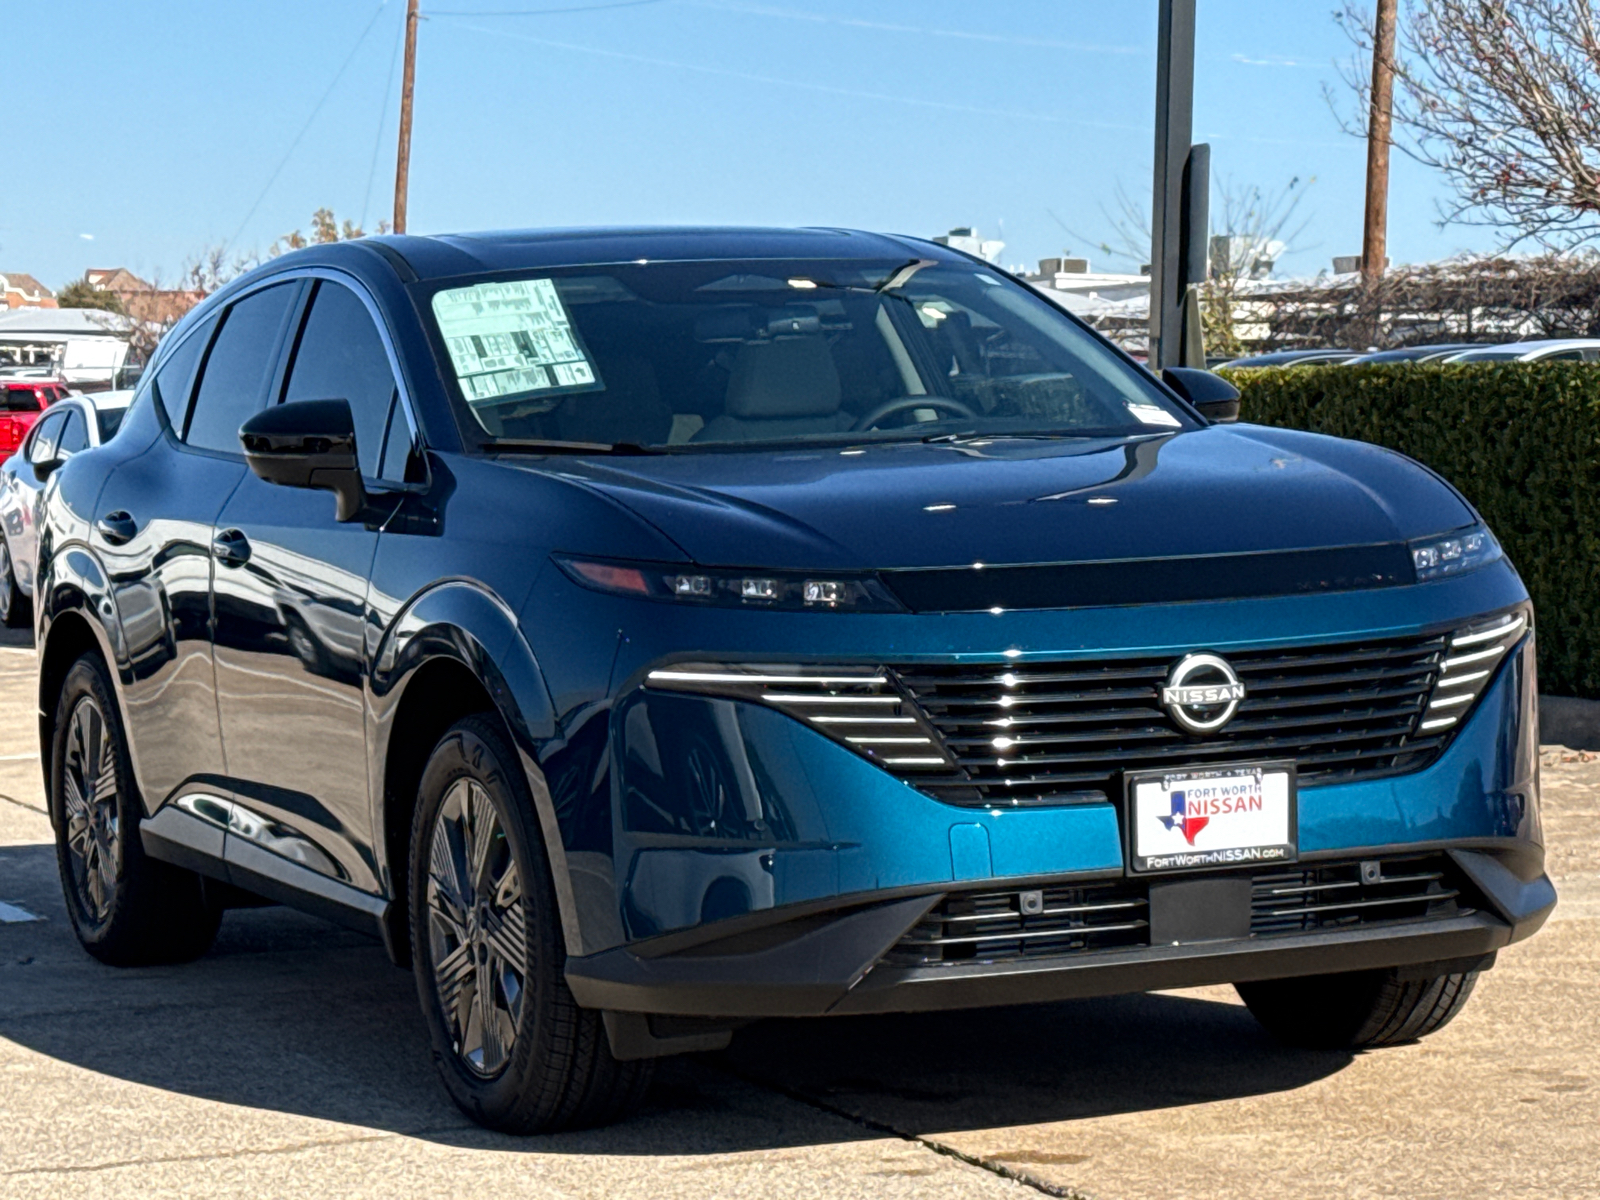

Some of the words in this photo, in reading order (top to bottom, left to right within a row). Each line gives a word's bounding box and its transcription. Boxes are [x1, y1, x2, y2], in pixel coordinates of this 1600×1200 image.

[1165, 686, 1244, 703] NISSAN
[1187, 788, 1218, 799] FORT
[1220, 784, 1262, 796] WORTH
[1188, 795, 1263, 816] NISSAN
